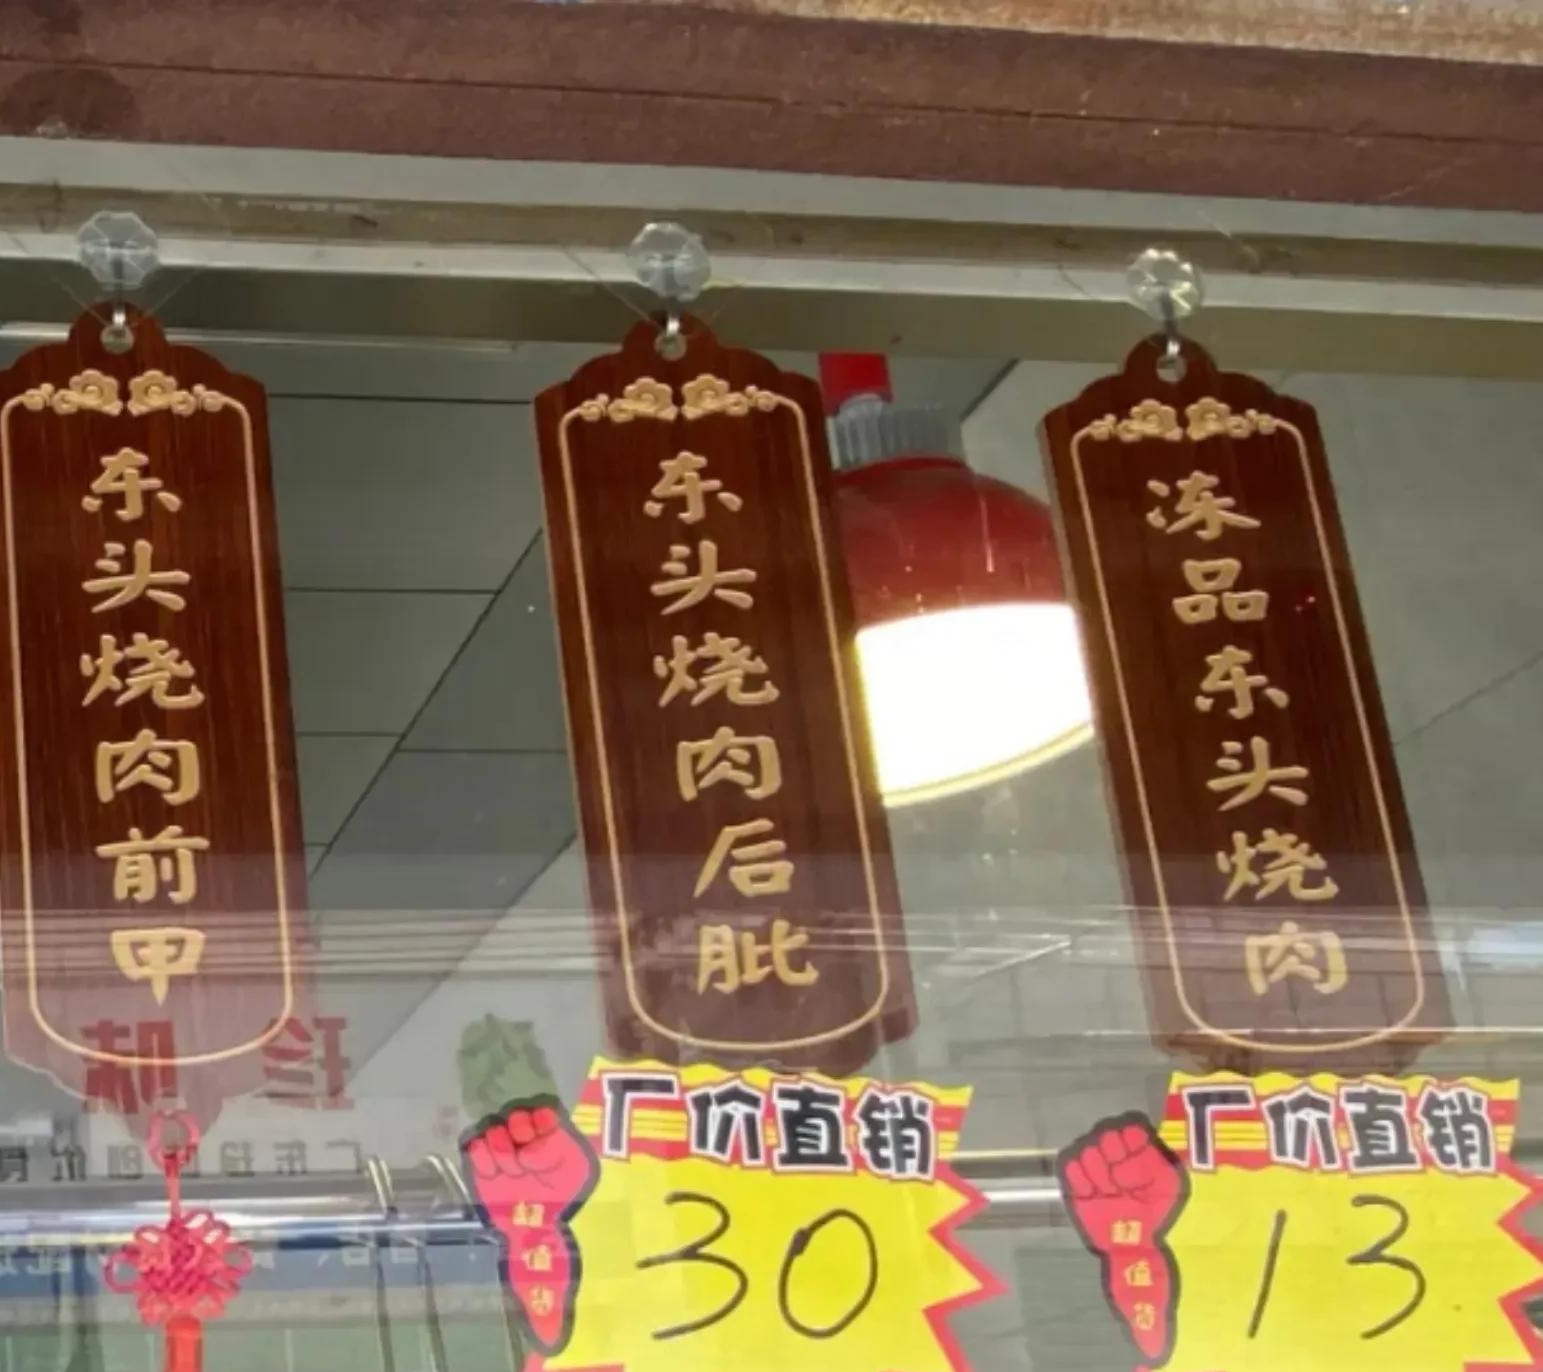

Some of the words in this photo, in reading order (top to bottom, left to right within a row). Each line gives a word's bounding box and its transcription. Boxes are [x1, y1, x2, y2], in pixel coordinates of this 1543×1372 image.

[79, 447, 211, 1005] 东头烧肉前甲
[1146, 470, 1348, 995] 冻品东头烧肉
[600, 1072, 938, 1182] 厂价直销
[1183, 1082, 1497, 1174] 厂价直销
[636, 1190, 878, 1340] 30
[1246, 1193, 1428, 1341] 13
